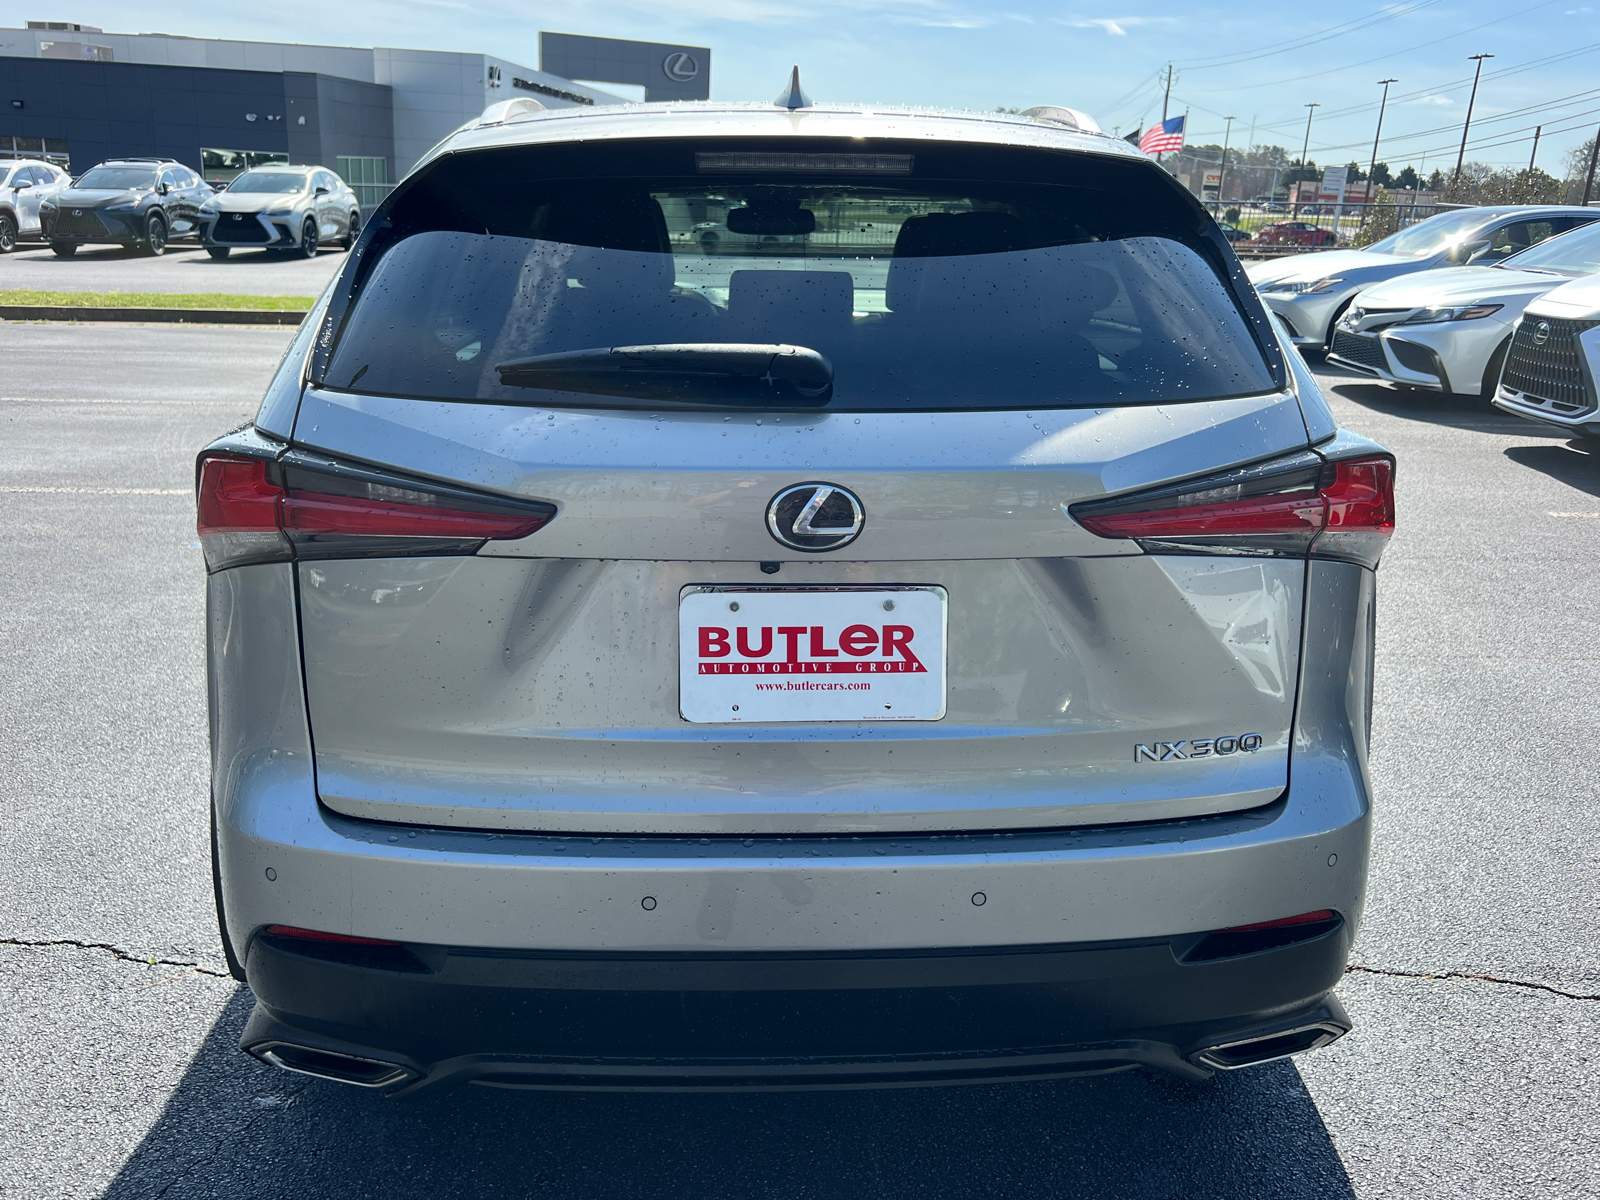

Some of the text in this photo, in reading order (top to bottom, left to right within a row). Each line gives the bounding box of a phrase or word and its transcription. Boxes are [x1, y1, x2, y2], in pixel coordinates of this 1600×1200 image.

[700, 662, 920, 674] AUTOMOTIVE GROUP
[756, 681, 871, 691] www.butlercars.com
